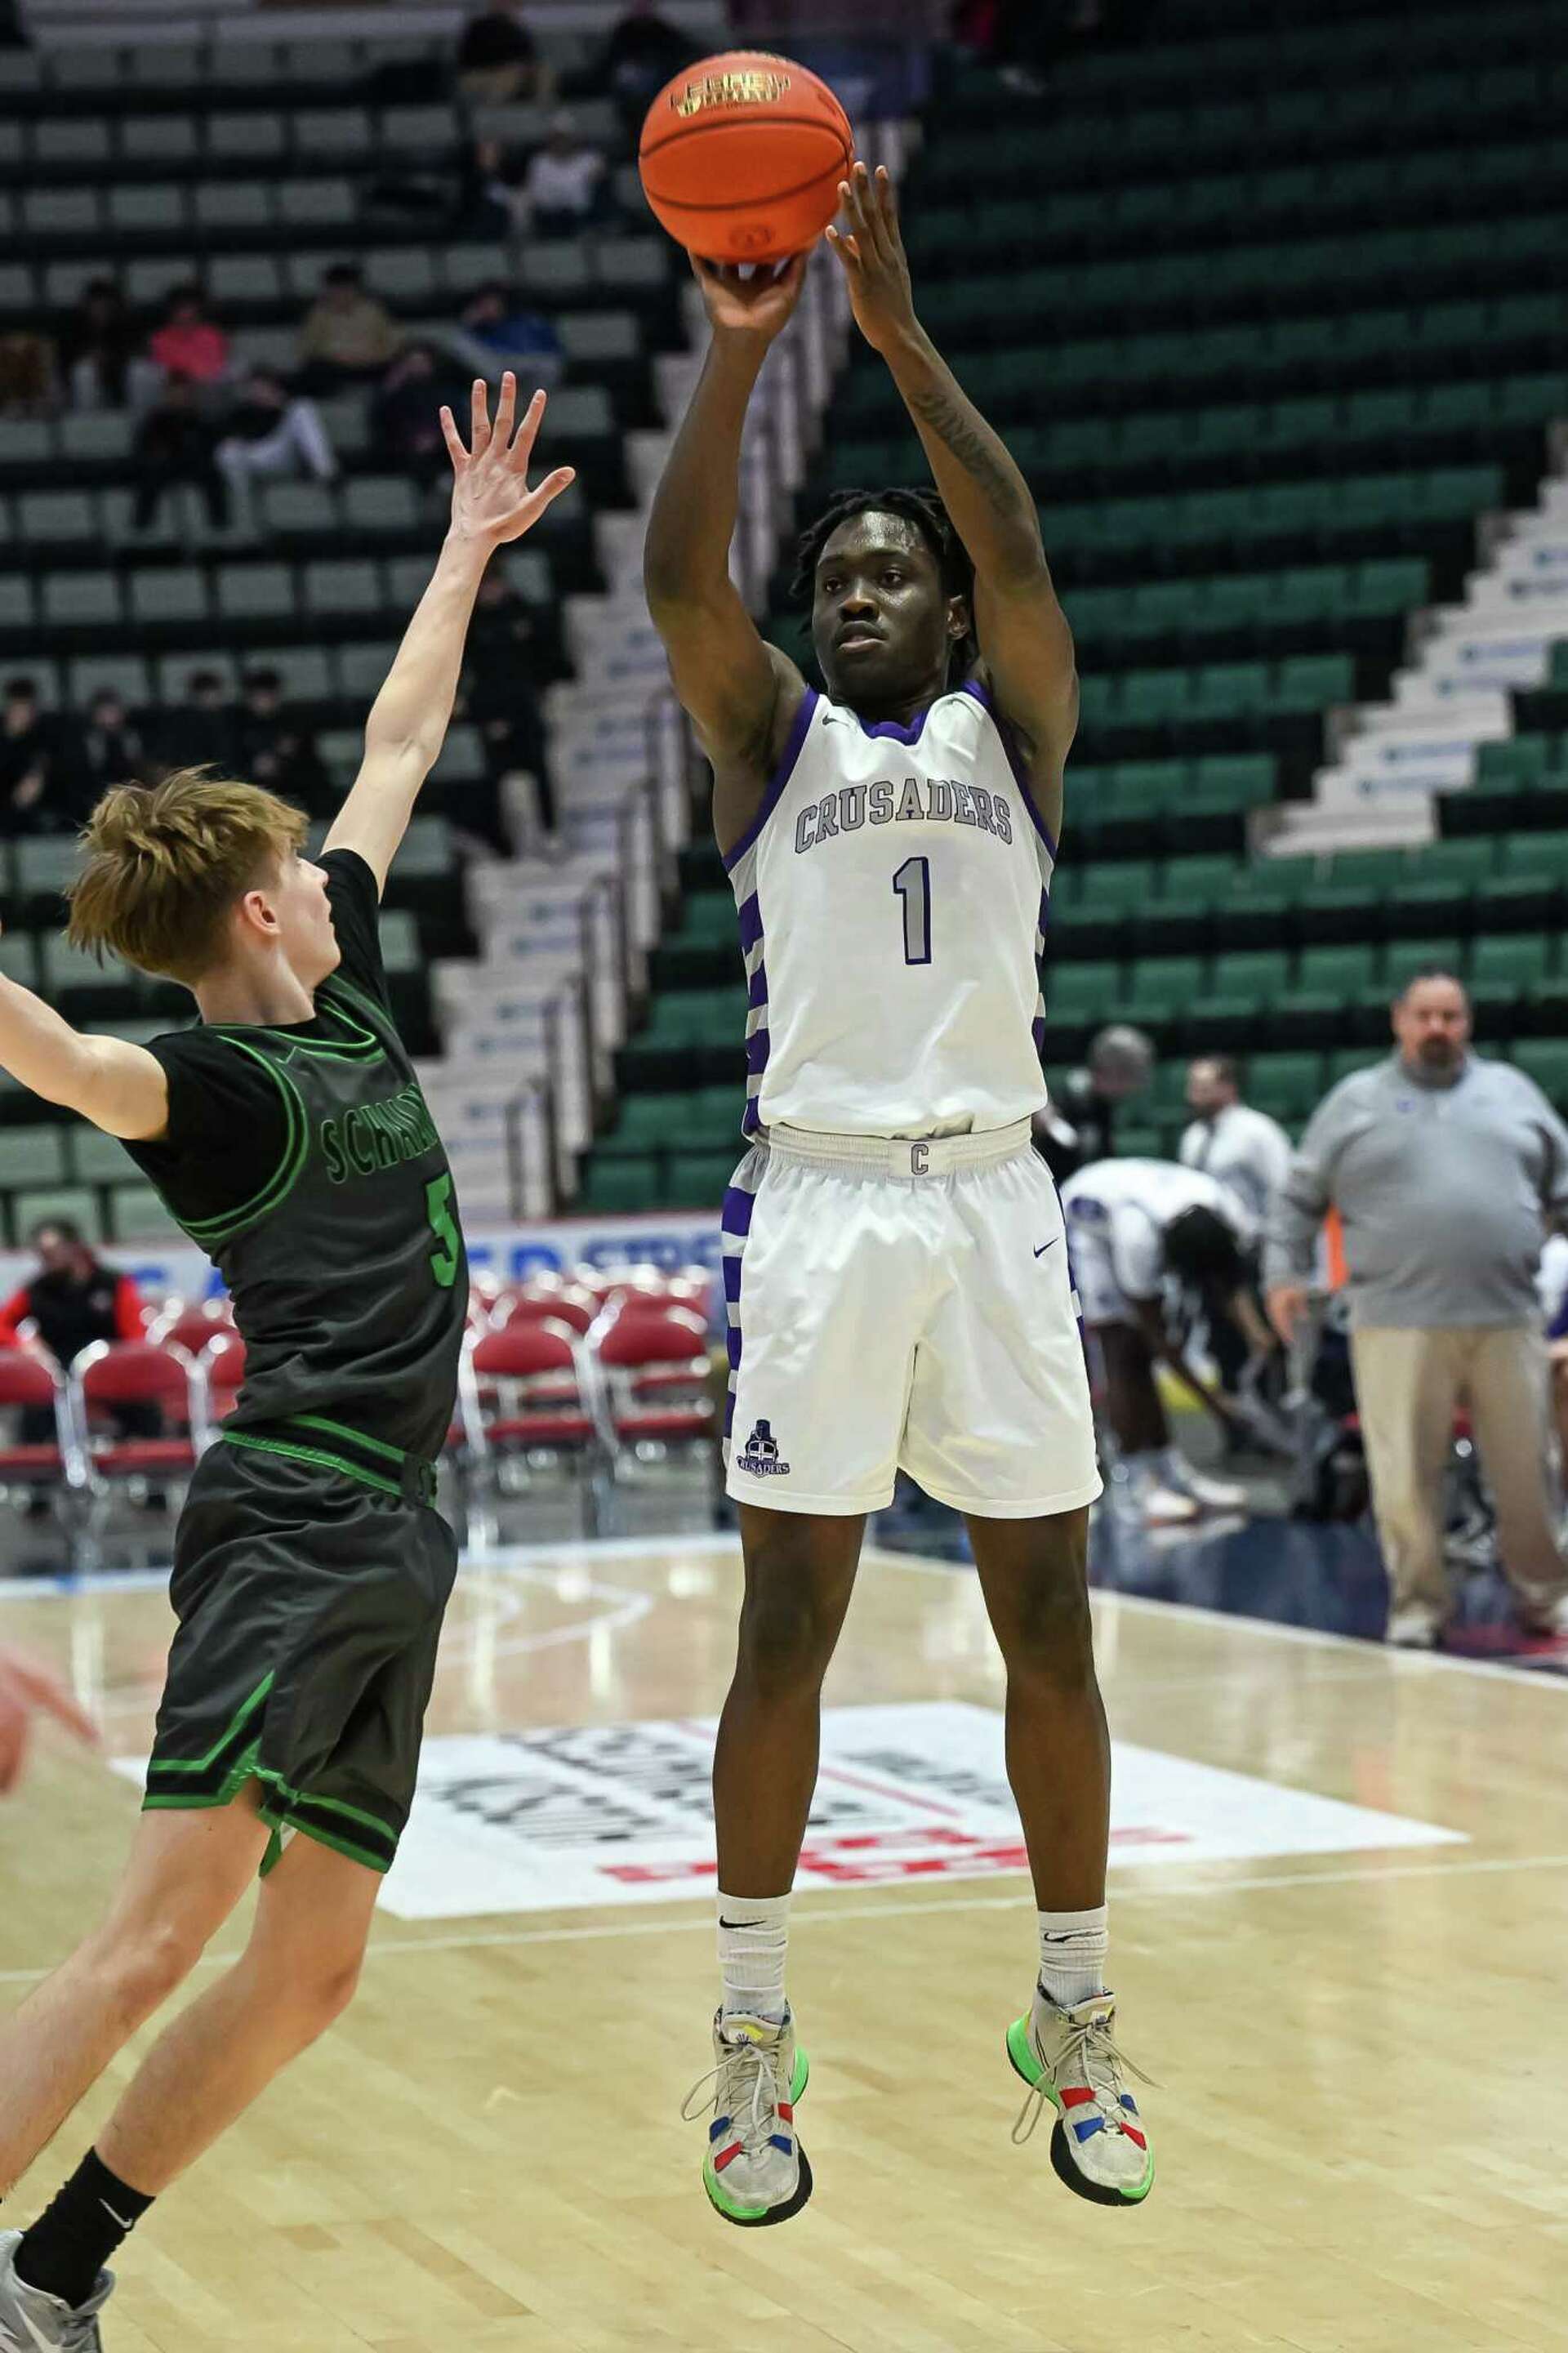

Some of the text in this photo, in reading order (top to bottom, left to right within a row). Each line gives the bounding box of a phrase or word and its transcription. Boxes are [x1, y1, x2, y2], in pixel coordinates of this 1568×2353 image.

[795, 778, 1013, 853] CRUSADERS
[893, 856, 932, 965] 1
[911, 1143, 929, 1175] C
